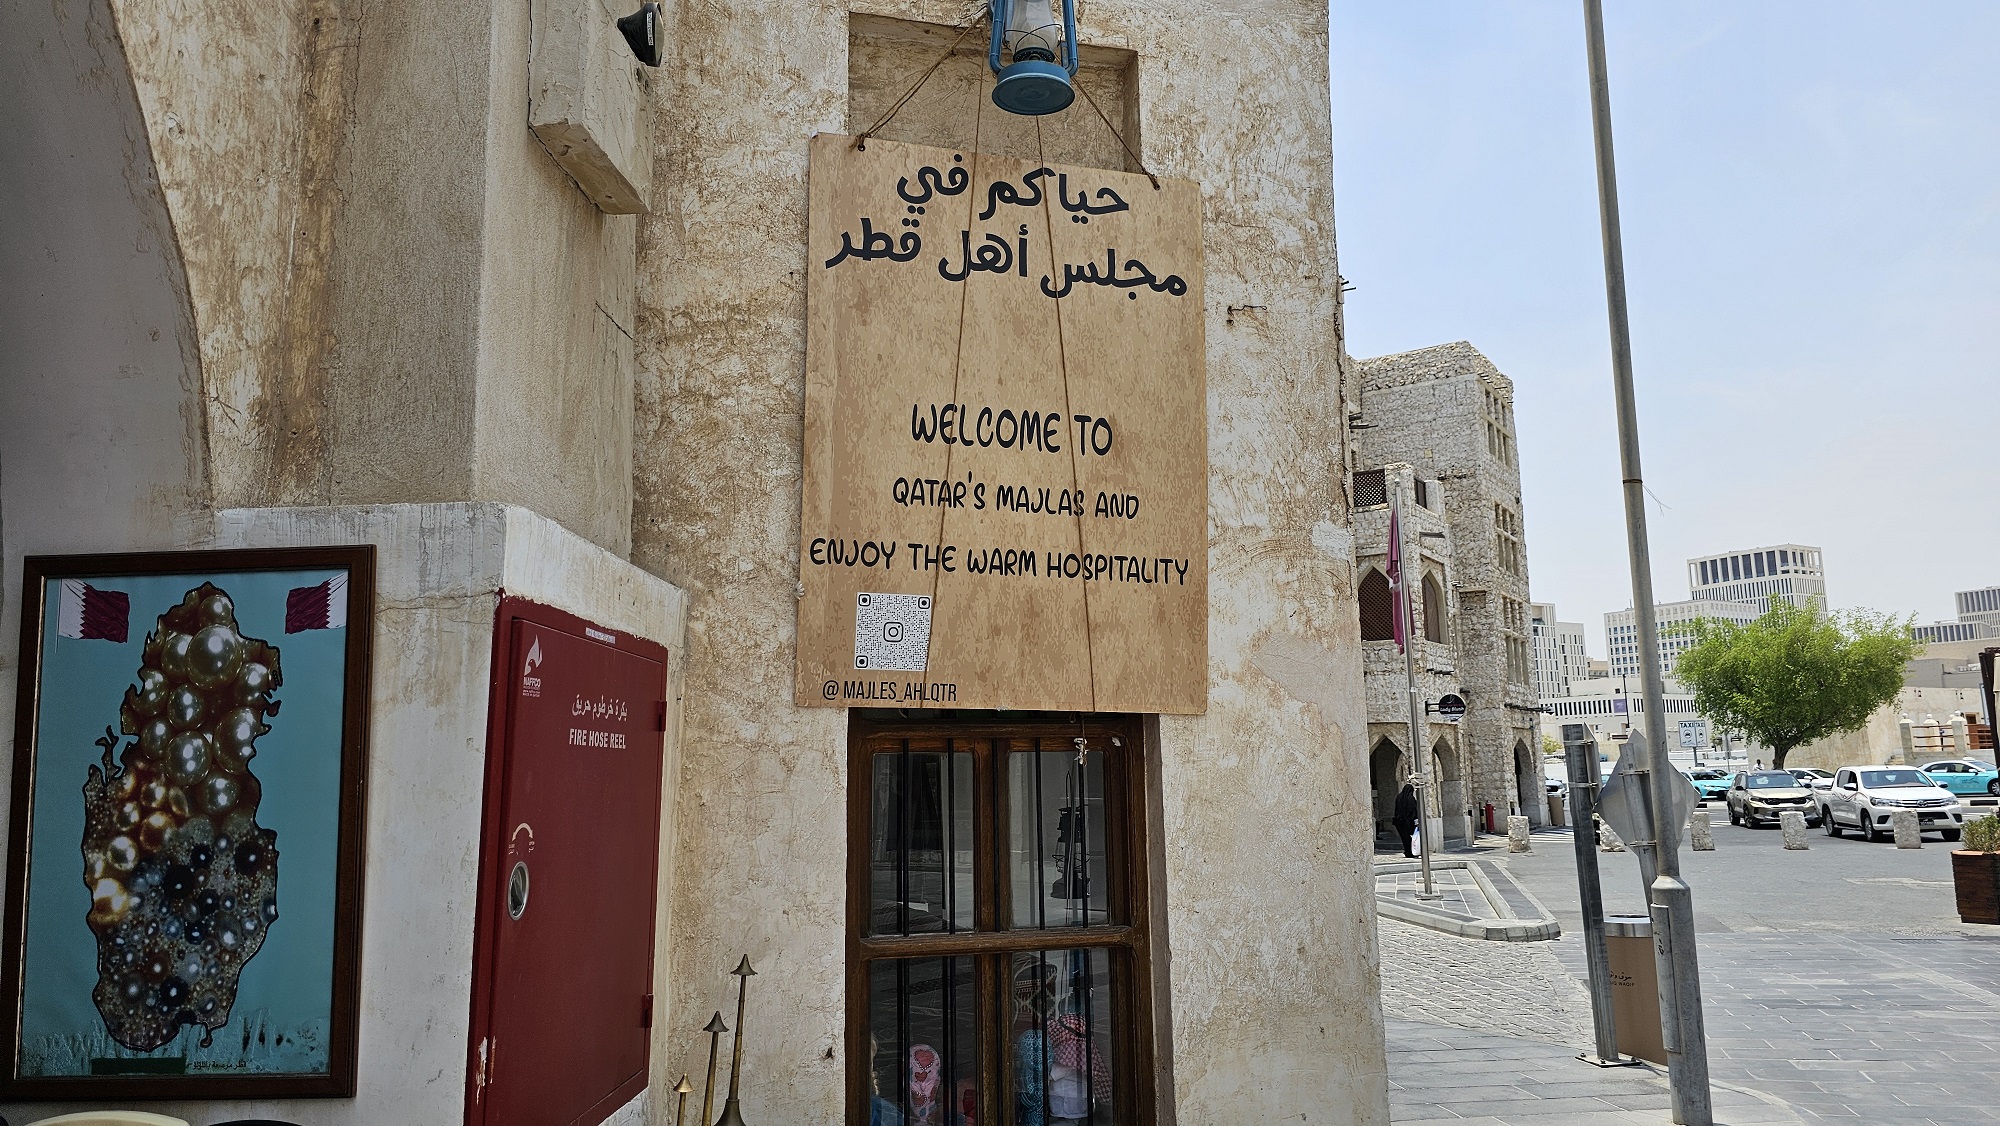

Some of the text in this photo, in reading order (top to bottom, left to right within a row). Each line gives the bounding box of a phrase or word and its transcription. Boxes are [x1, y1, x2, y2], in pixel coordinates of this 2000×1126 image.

[896, 154, 1130, 224] حياكم في
[825, 217, 1188, 300] مجلس أهل قطر
[911, 403, 1113, 457] WELCOME TO
[892, 470, 1140, 520] QATAR'S MAJLAS AND
[809, 537, 1189, 586] ENJOY THE WARM HOSPITALITY
[571, 693, 591, 716] حريق
[592, 694, 614, 720] خرطوم
[843, 680, 957, 703] MAJLES_AHLQTR
[569, 728, 626, 750] FIRE HOSE REEL
